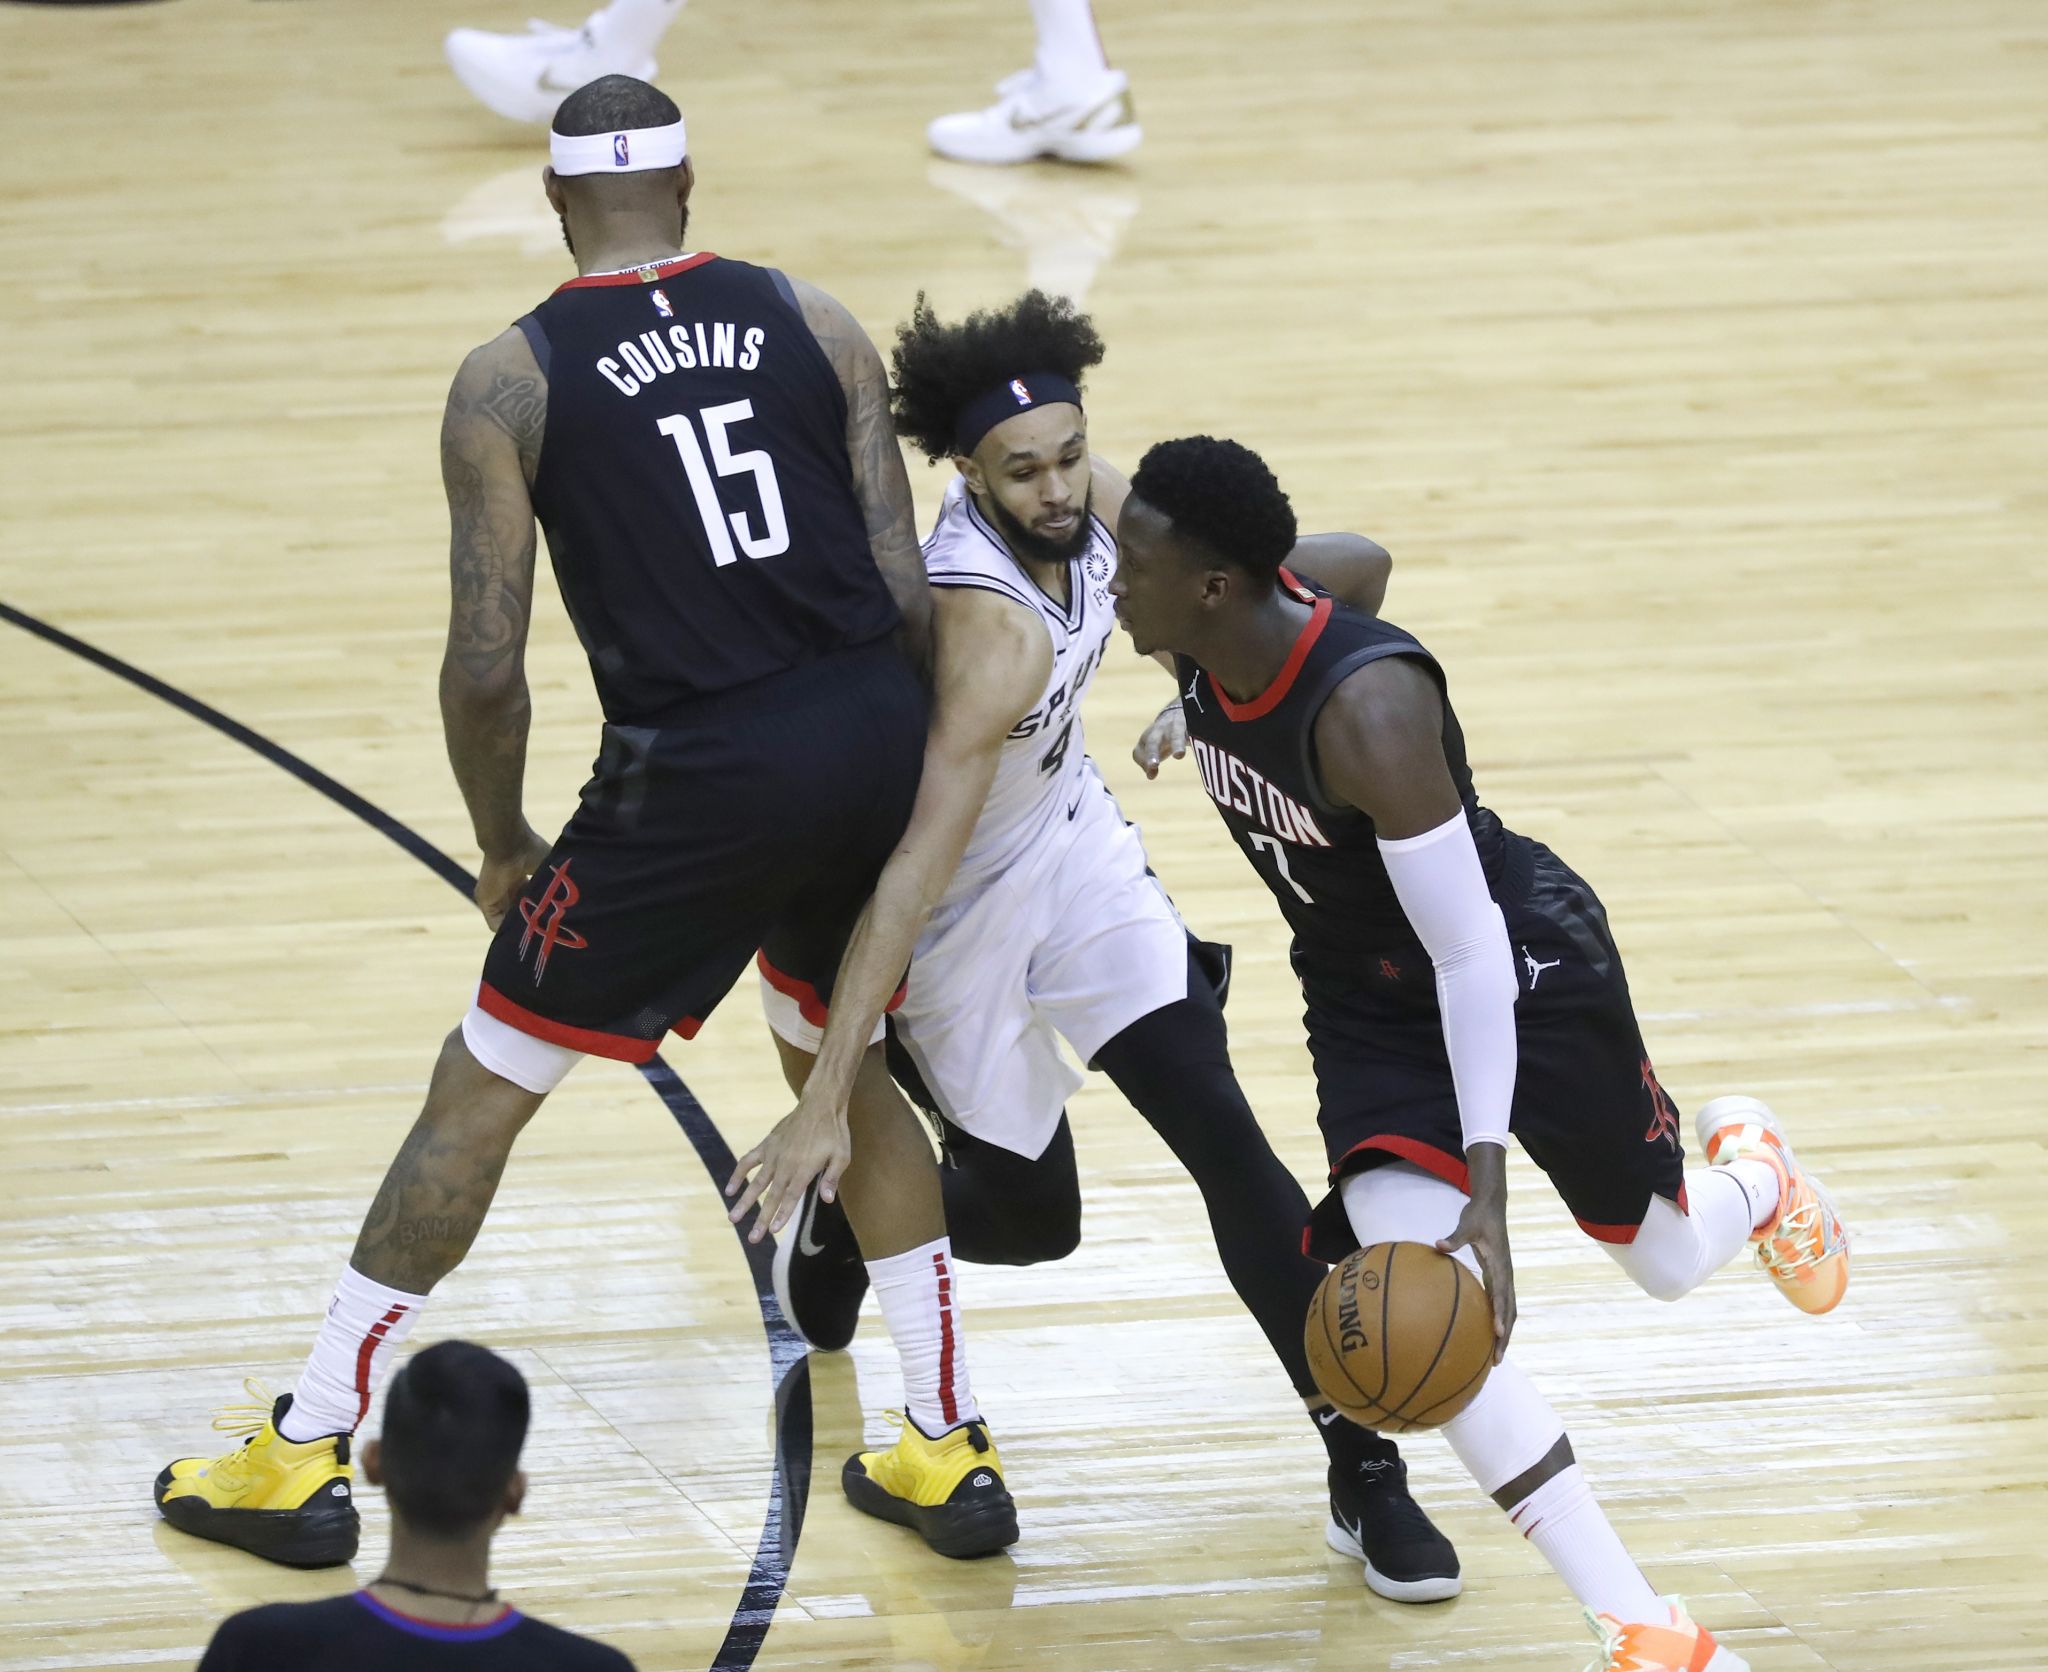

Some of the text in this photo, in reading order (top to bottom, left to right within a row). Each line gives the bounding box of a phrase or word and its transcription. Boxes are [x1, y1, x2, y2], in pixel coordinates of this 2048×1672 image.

[596, 322, 765, 398] COUSINS
[656, 398, 790, 568] 15
[1037, 714, 1074, 779] 4
[1189, 735, 1333, 848] OUSTON
[1248, 831, 1315, 904] 7
